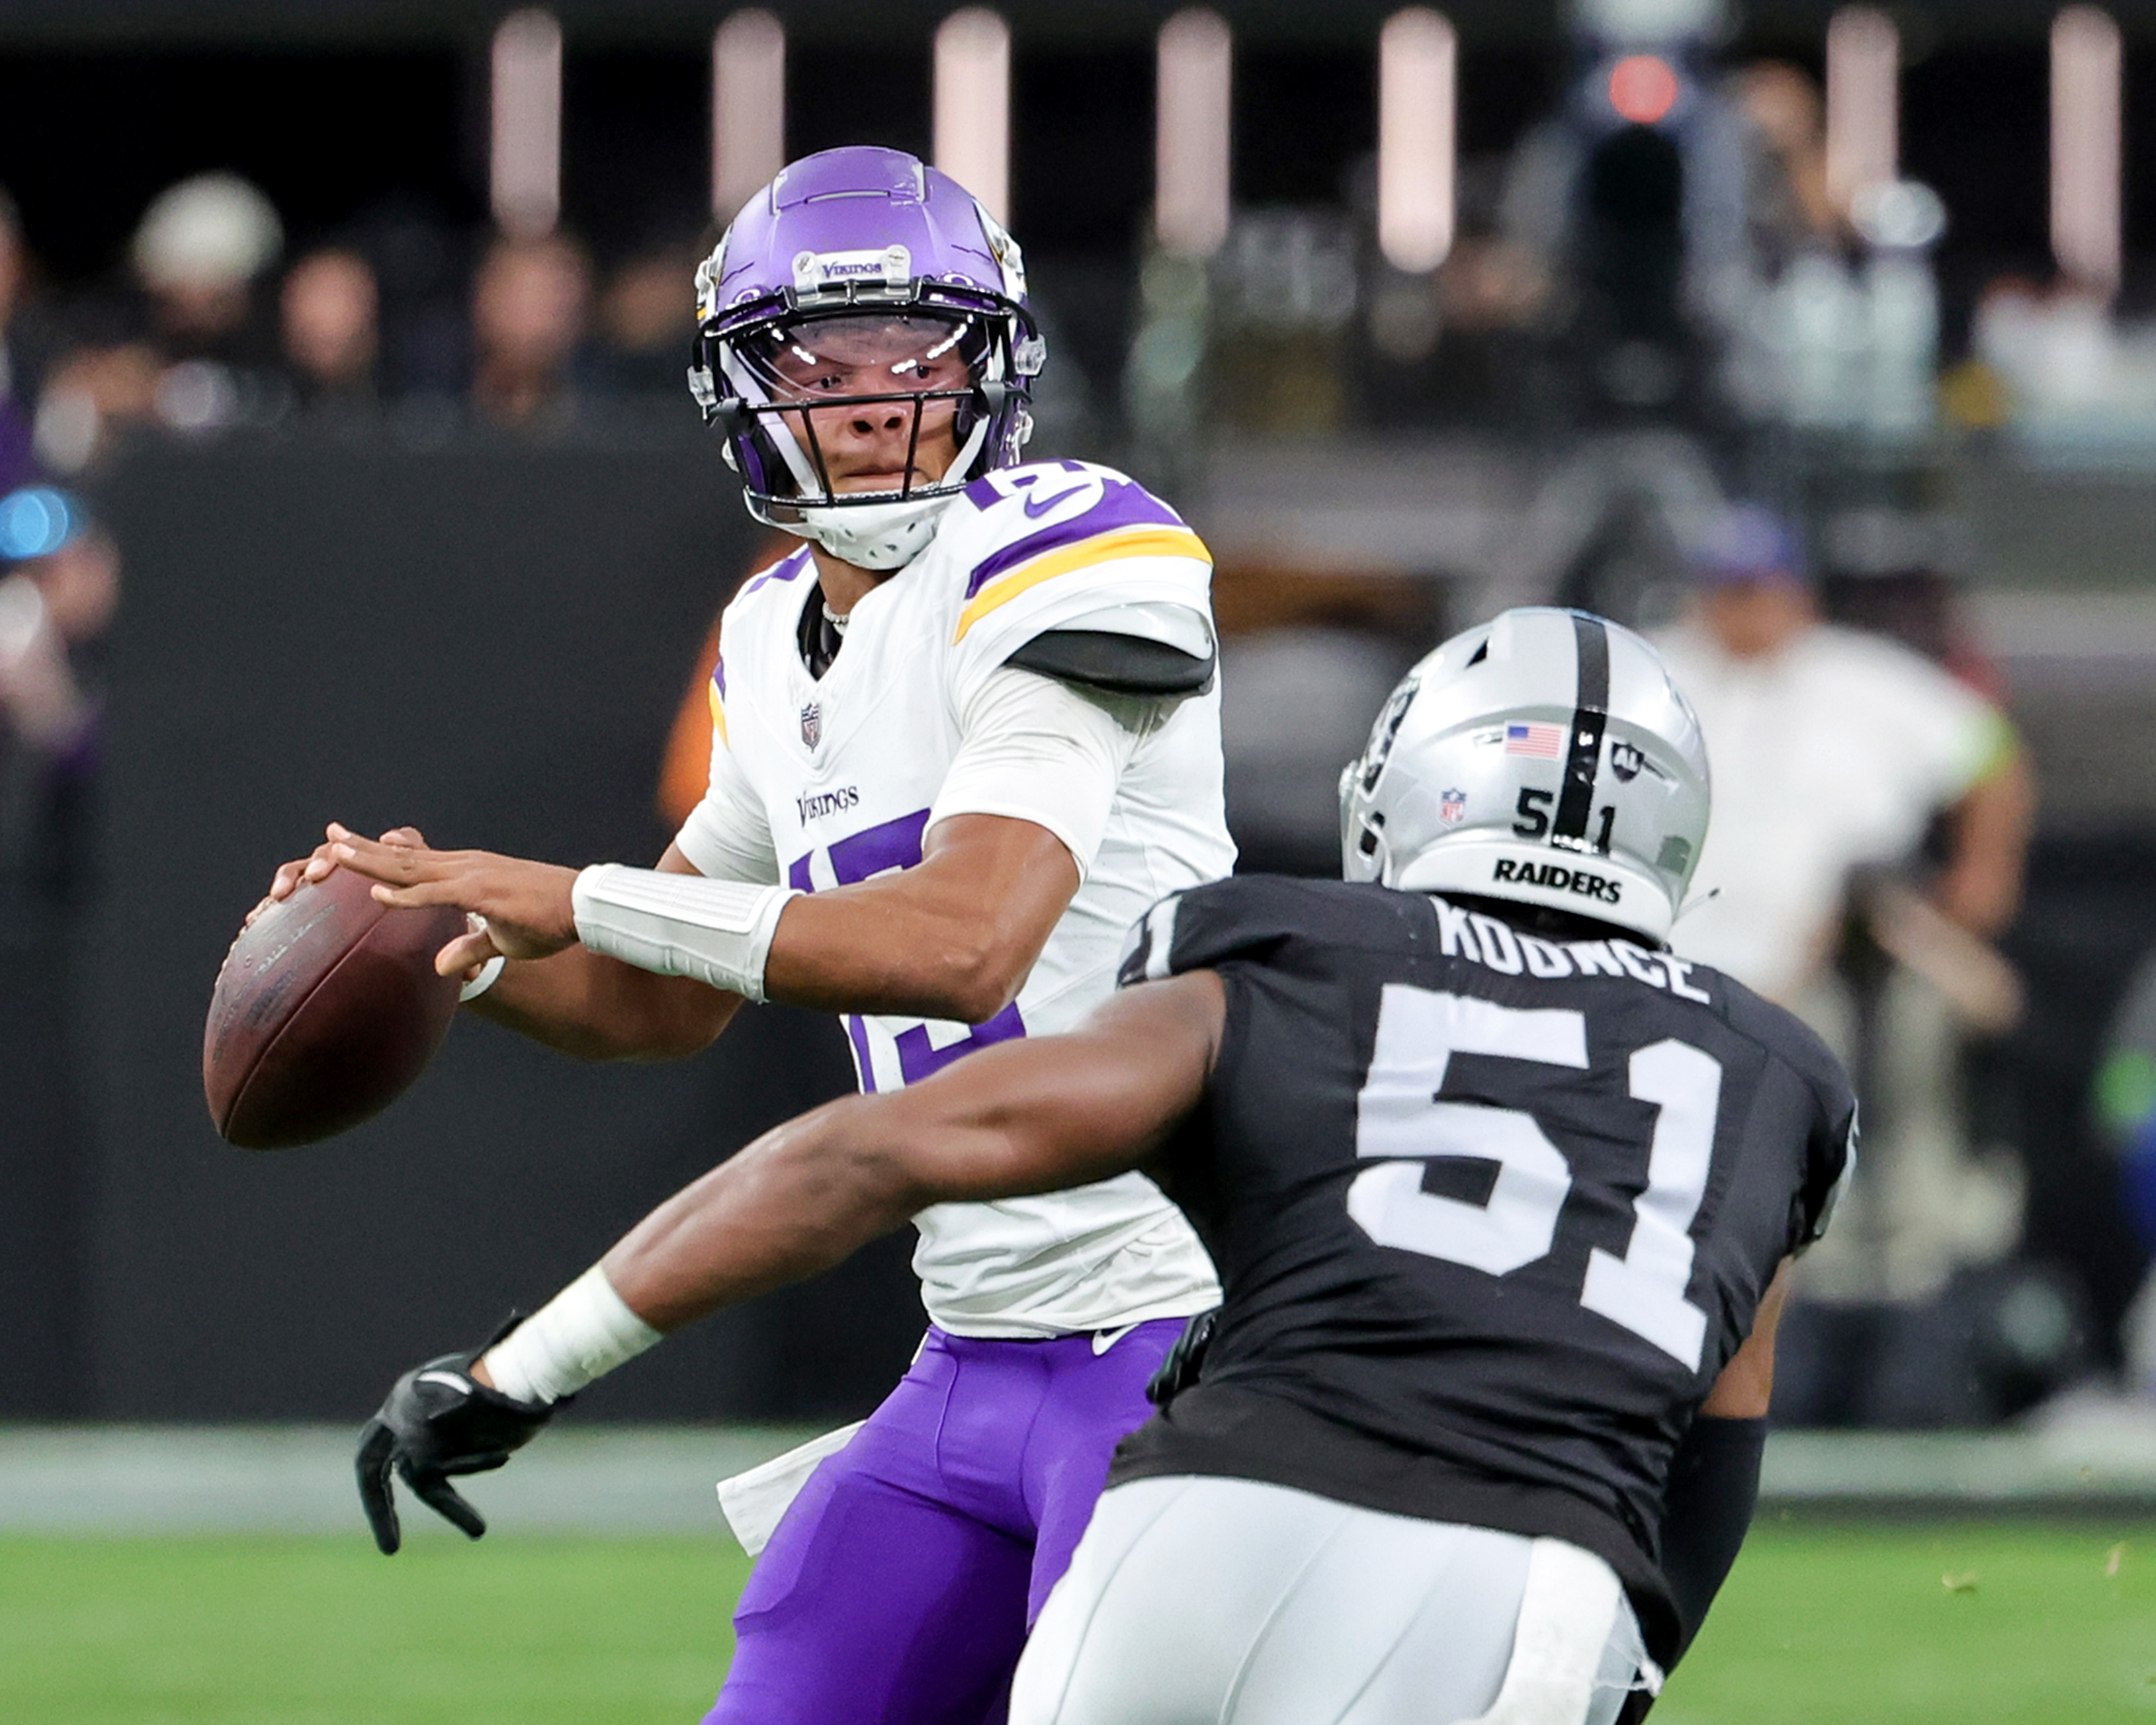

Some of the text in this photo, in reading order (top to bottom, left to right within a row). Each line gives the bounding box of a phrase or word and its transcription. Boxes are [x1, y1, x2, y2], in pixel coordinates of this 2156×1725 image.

[1493, 859, 1623, 905] RAIDERS
[1428, 895, 1711, 1005] KOONCE
[1347, 983, 1721, 1374] 51
